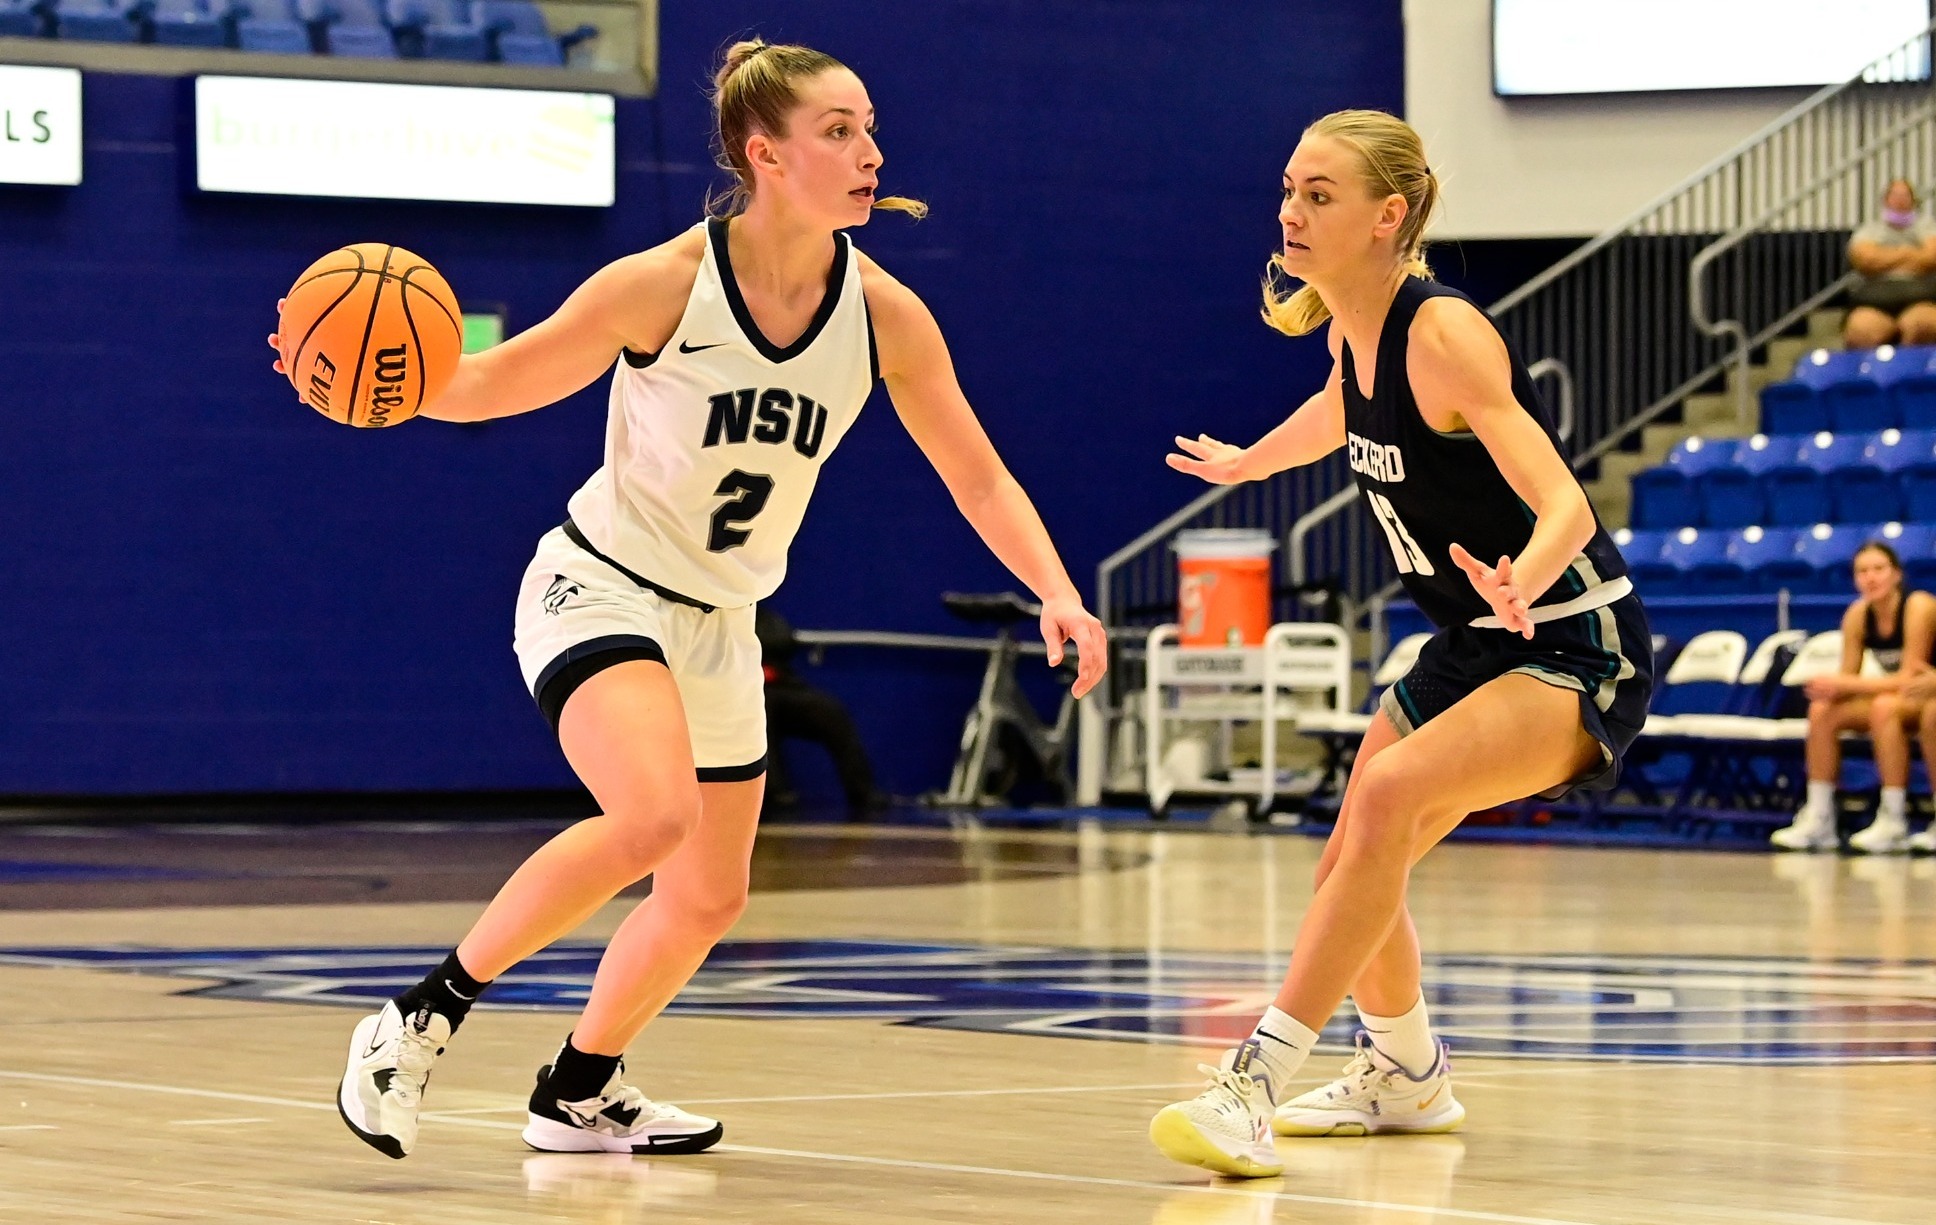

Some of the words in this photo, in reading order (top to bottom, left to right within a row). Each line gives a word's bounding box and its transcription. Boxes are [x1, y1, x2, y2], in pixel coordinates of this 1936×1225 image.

[6, 110, 51, 143] LS
[701, 387, 828, 460] NSU
[1347, 431, 1406, 483] ECKERD
[705, 468, 776, 554] 2
[1366, 489, 1435, 577] 13
